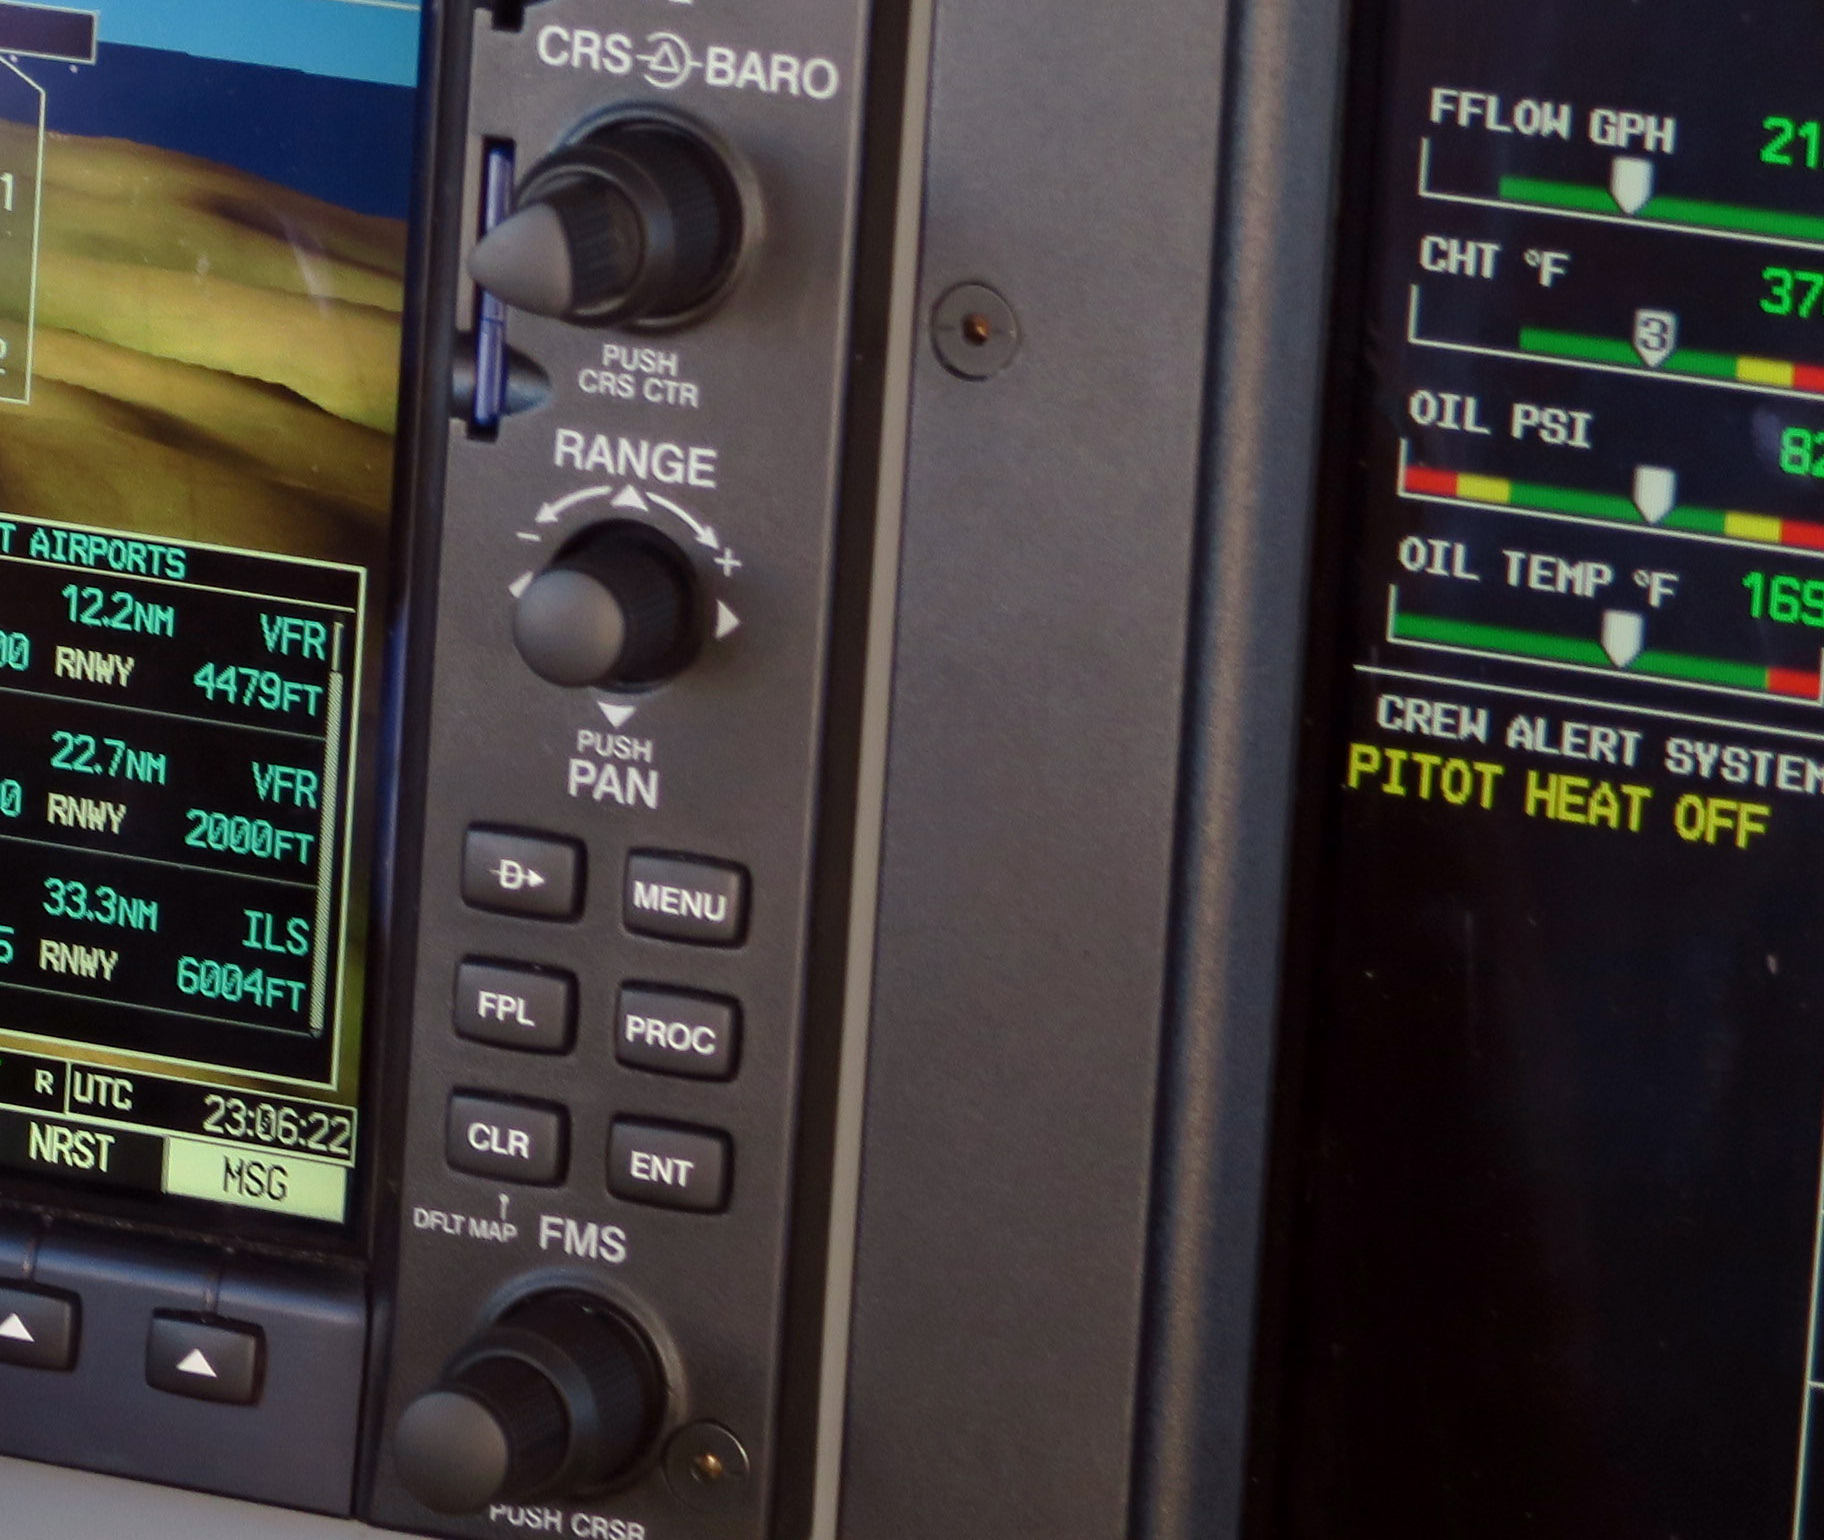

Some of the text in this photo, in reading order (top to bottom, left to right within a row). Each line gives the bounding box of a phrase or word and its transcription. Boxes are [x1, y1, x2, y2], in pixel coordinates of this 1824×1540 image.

[537, 25, 838, 100] CRS BARO
[1429, 88, 1677, 155] FFLOW GPH
[1419, 235, 1500, 278] CHT
[602, 343, 678, 377] PUSH
[578, 370, 699, 407] CRS CTR
[1409, 390, 1592, 450] OIL PSI
[554, 428, 718, 489] RANGE
[30, 530, 186, 580] AIRPORTS
[1399, 536, 1614, 598] OIL TEMP
[62, 584, 173, 638] 12.2NM
[260, 612, 326, 660] VFR
[55, 645, 134, 687] RNWY
[193, 662, 323, 717] 4479FT
[577, 729, 652, 764] PUSH
[1377, 693, 1642, 768] CREW ALERT
[51, 730, 166, 785] 22.7NM
[252, 760, 318, 808] VFR
[568, 759, 659, 809] PAN
[1348, 742, 1770, 851] PITOT HEAT OFF
[48, 792, 126, 834] RNWY
[185, 809, 314, 863] 2000FT
[43, 877, 158, 932] 33.3NM
[243, 908, 309, 955] ILS
[633, 882, 726, 922] MENU
[39, 938, 118, 981] RNWY
[177, 955, 305, 1012] 6004FT
[477, 989, 535, 1027] FPL
[625, 1016, 716, 1056] PROC
[74, 1073, 133, 1114] UTC
[204, 1094, 352, 1152] 23:06:22
[28, 1122, 115, 1174] NRST
[467, 1121, 529, 1160] CLR
[223, 1158, 290, 1204] MSG
[630, 1151, 692, 1189] ENT
[413, 1207, 517, 1244] DFLT MAP
[539, 1216, 627, 1263] FMS
